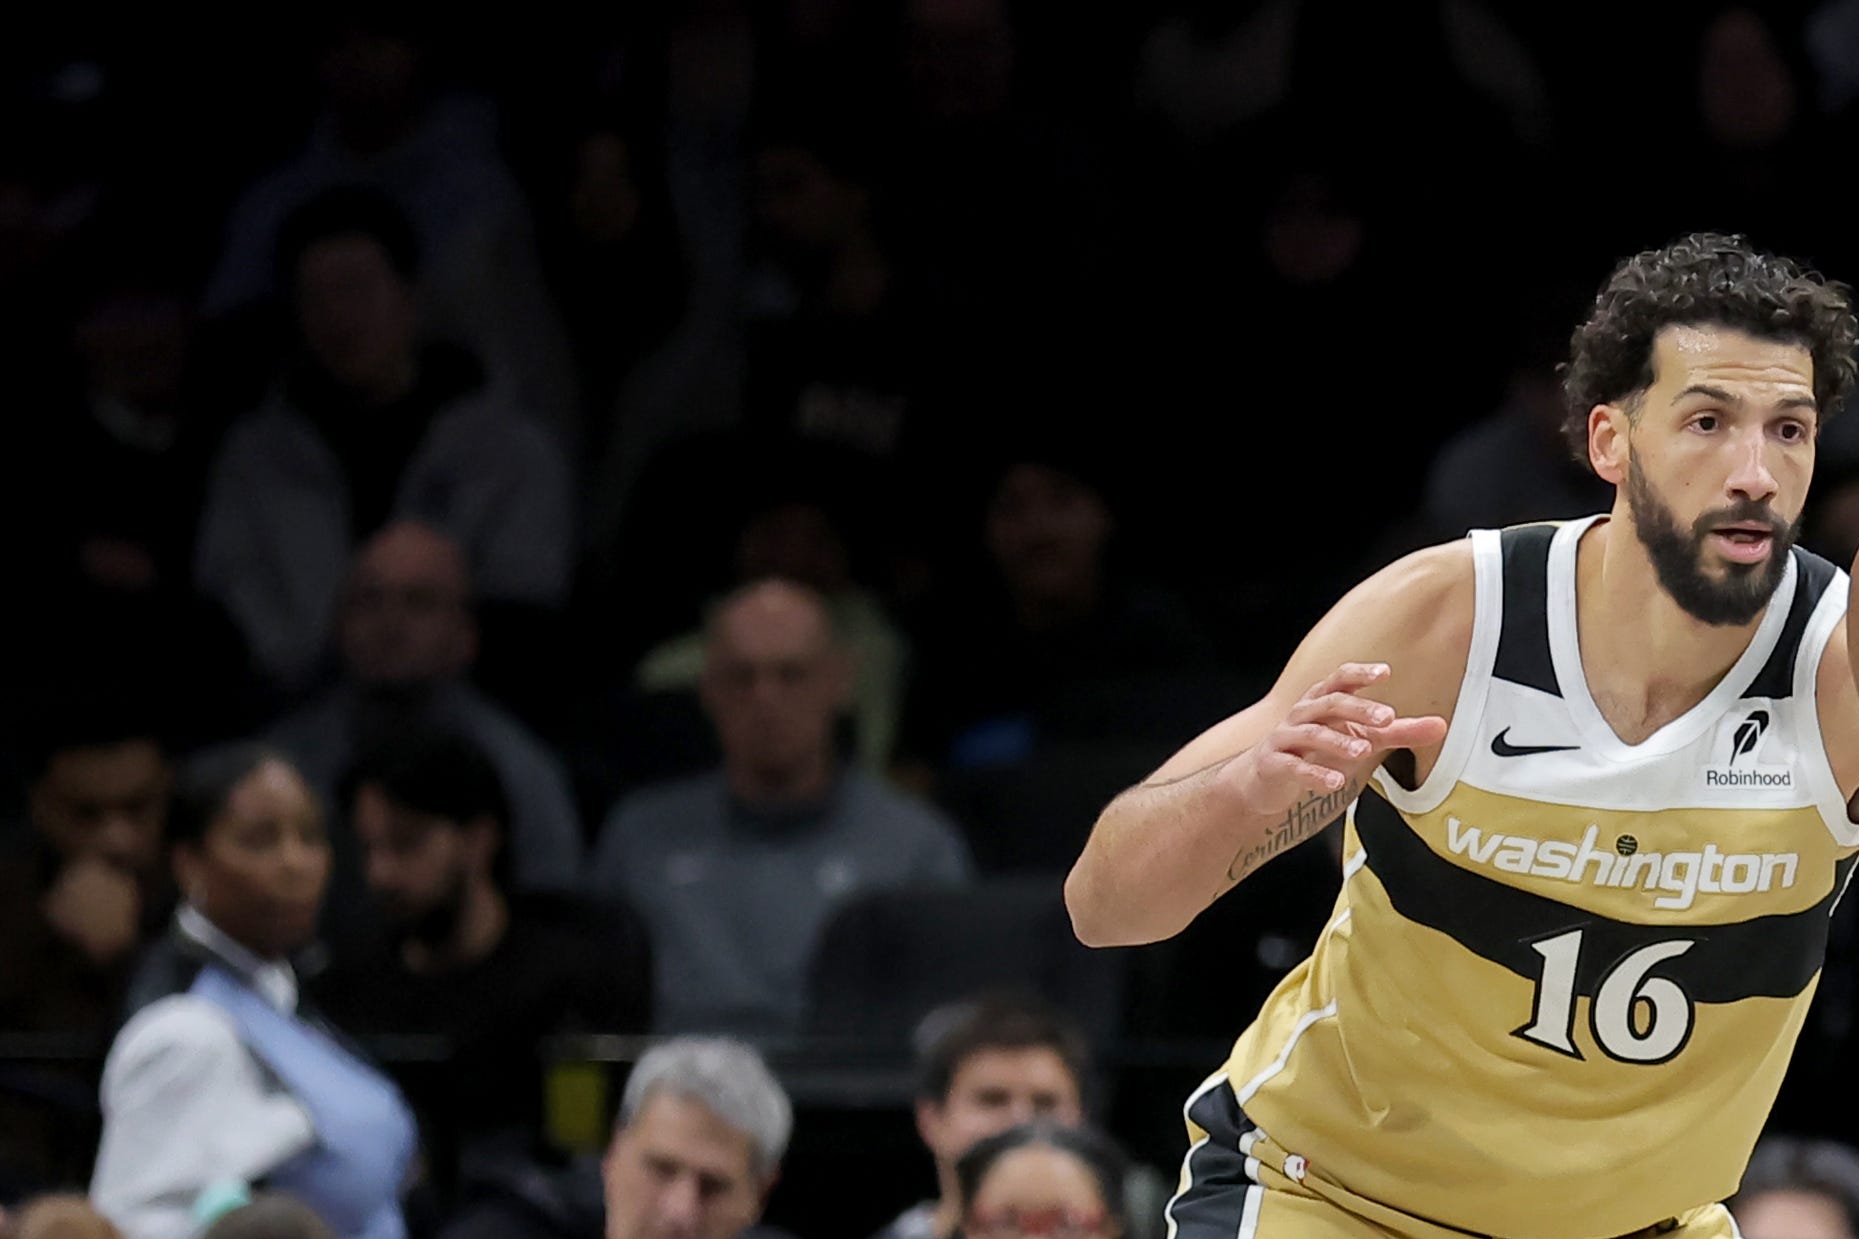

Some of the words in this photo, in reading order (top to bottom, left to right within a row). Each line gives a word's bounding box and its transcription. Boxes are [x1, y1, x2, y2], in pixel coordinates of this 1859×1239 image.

[1706, 769, 1791, 786] Robinhood
[1446, 816, 1799, 910] washington
[1509, 928, 1697, 1066] 16
